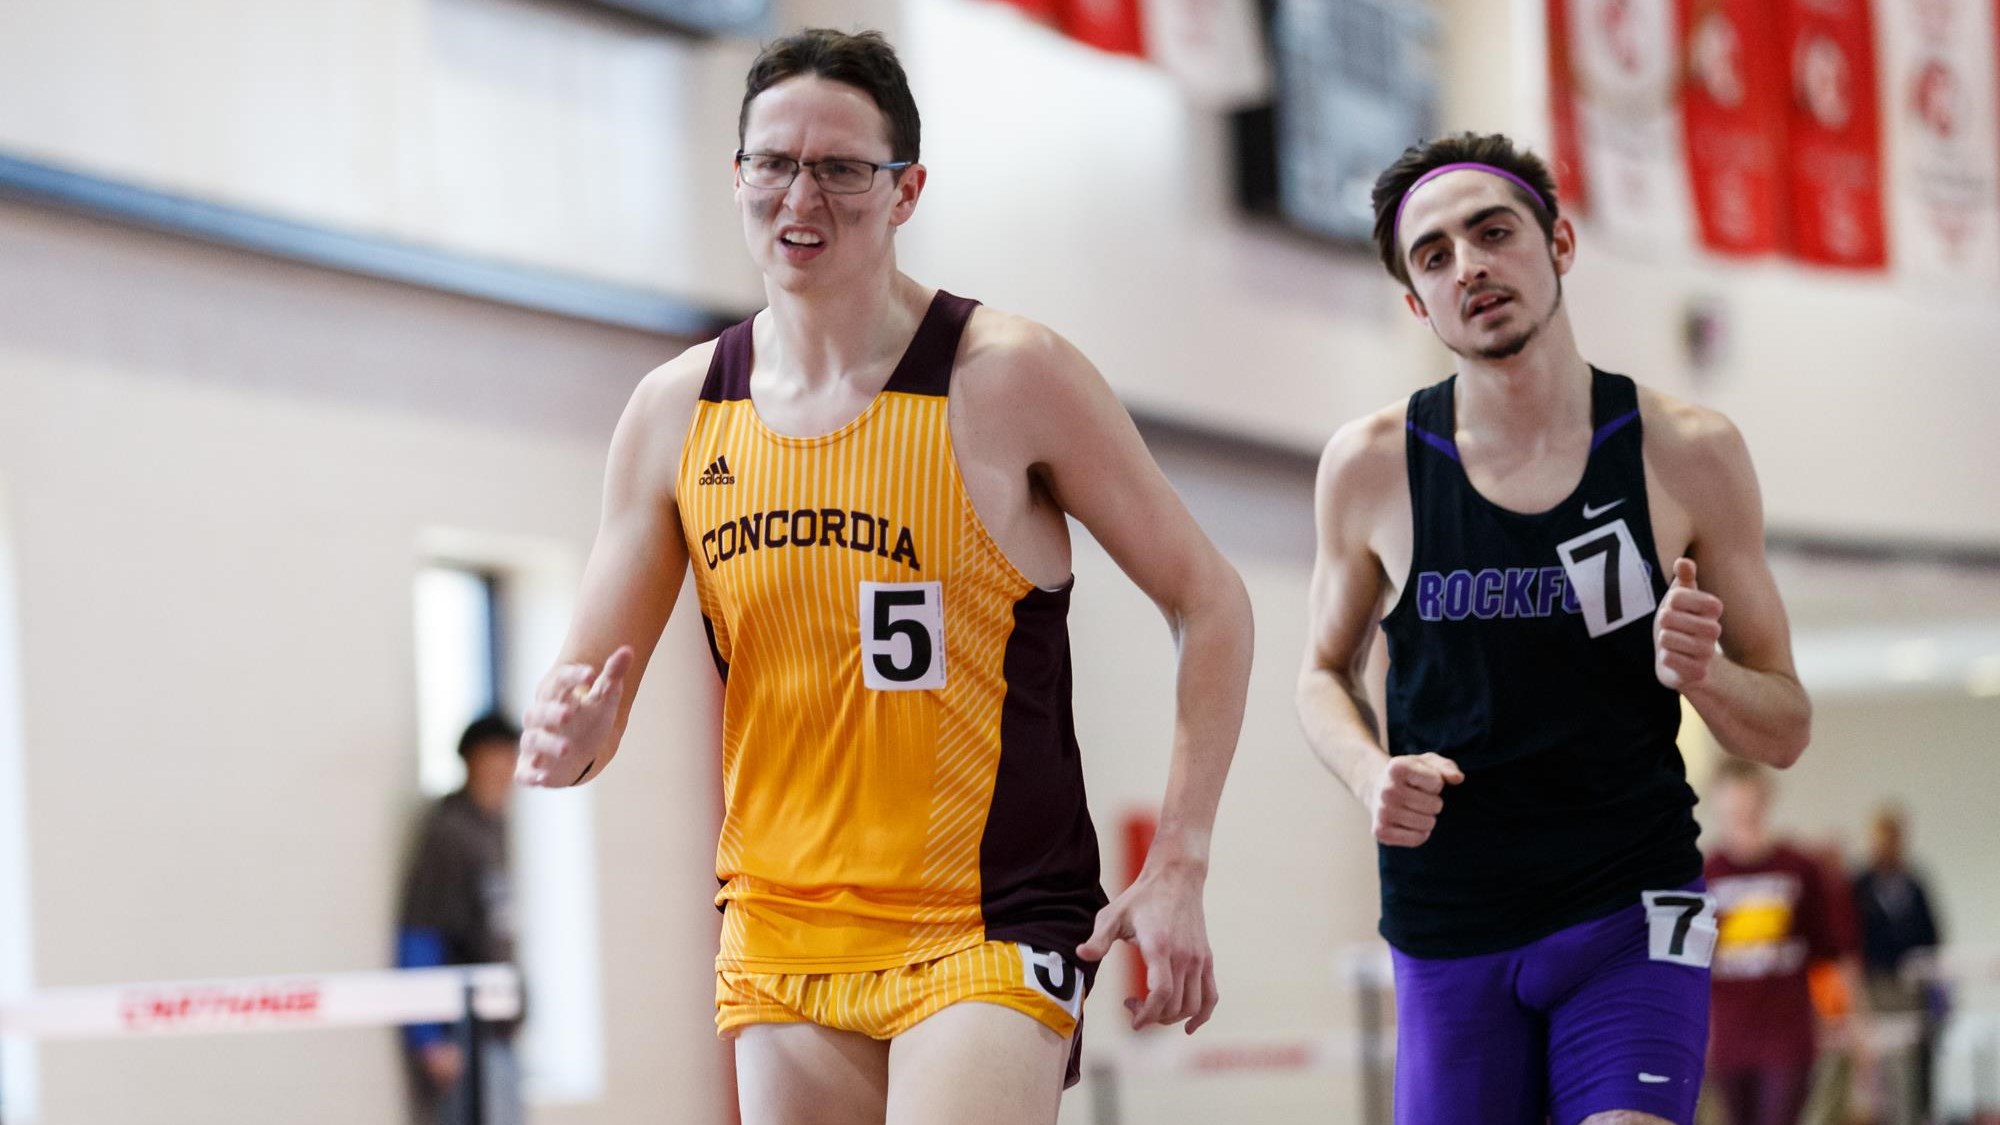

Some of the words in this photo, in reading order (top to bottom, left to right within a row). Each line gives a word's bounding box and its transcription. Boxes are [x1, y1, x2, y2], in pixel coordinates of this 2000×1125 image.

[699, 474, 735, 486] adidas
[701, 508, 920, 571] CONCORDIA
[1416, 560, 1653, 622] ROCKF
[1569, 530, 1624, 626] 7
[871, 590, 932, 682] 5
[1653, 896, 1705, 956] 7
